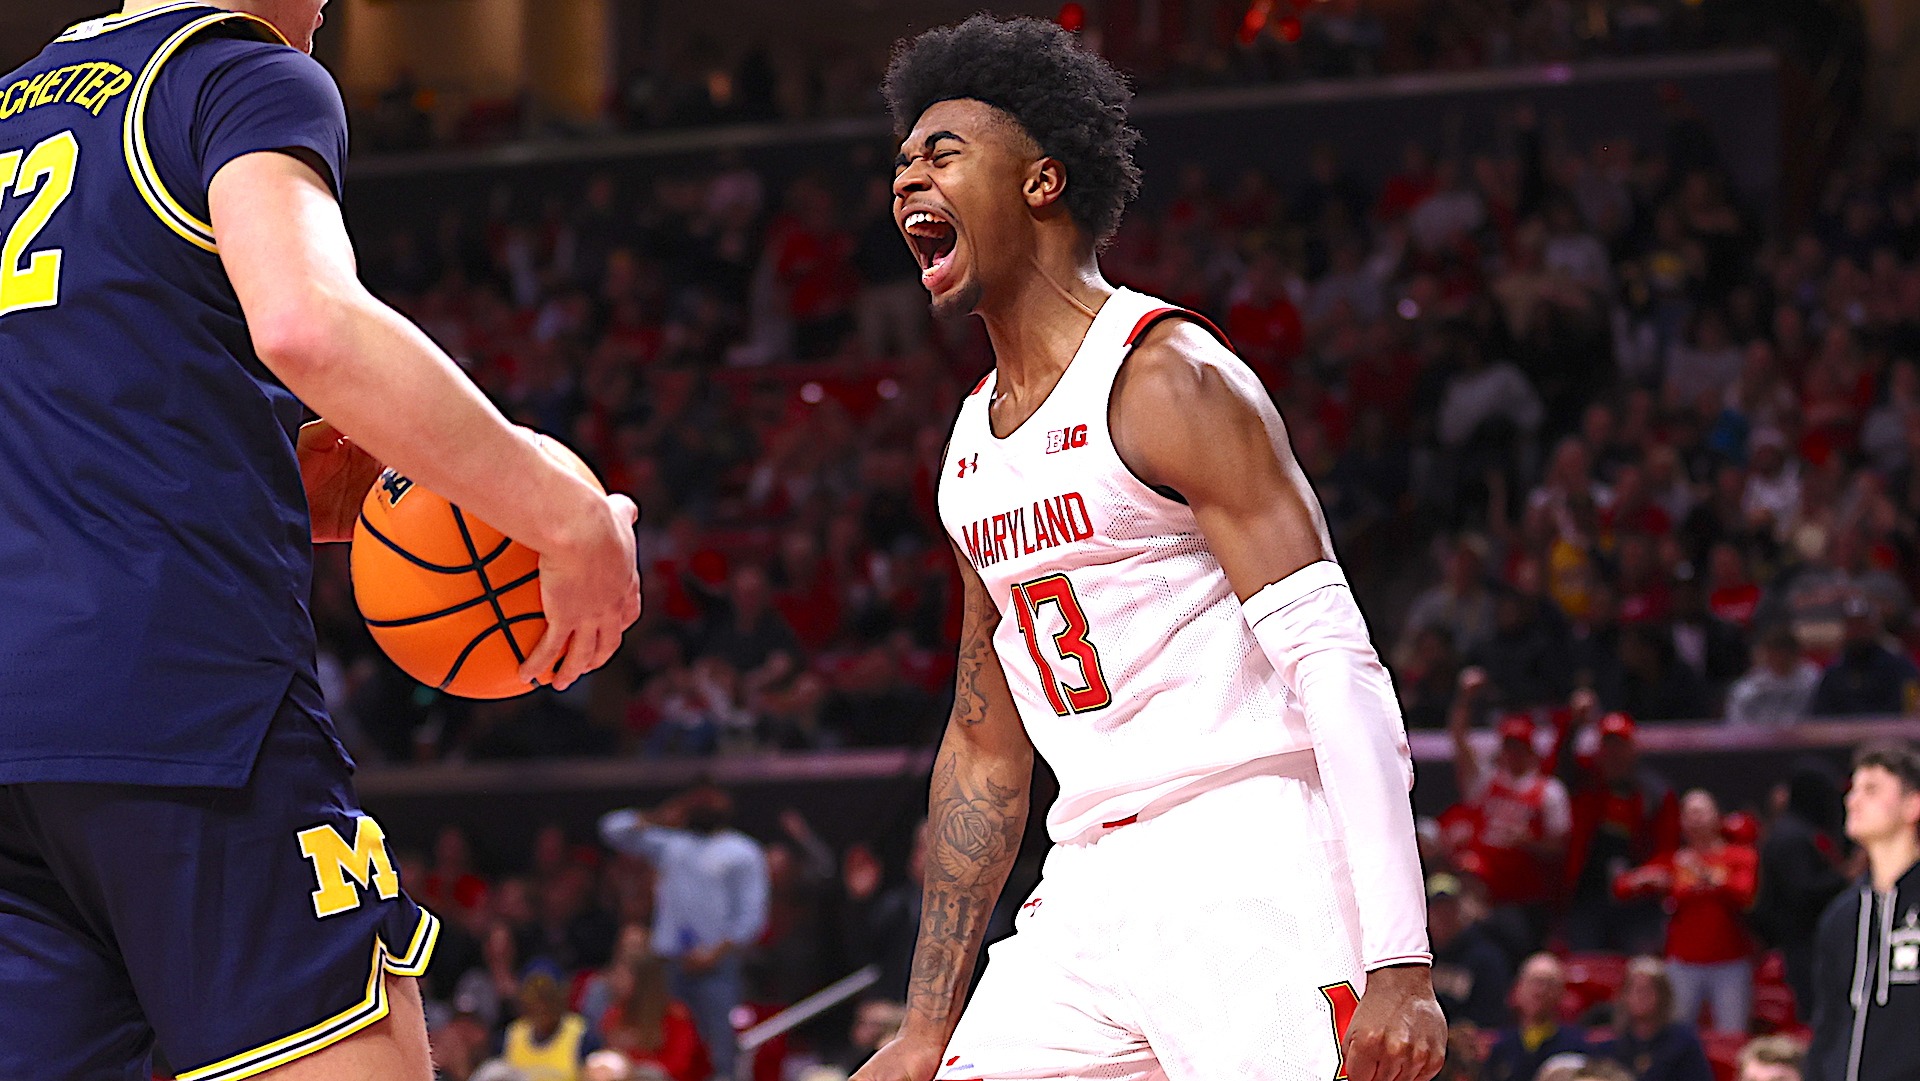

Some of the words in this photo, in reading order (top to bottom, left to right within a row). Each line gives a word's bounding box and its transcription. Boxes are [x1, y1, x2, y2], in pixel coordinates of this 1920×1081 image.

[962, 492, 1094, 571] MARYLAND
[1010, 573, 1112, 717] 13
[297, 816, 399, 918] M
